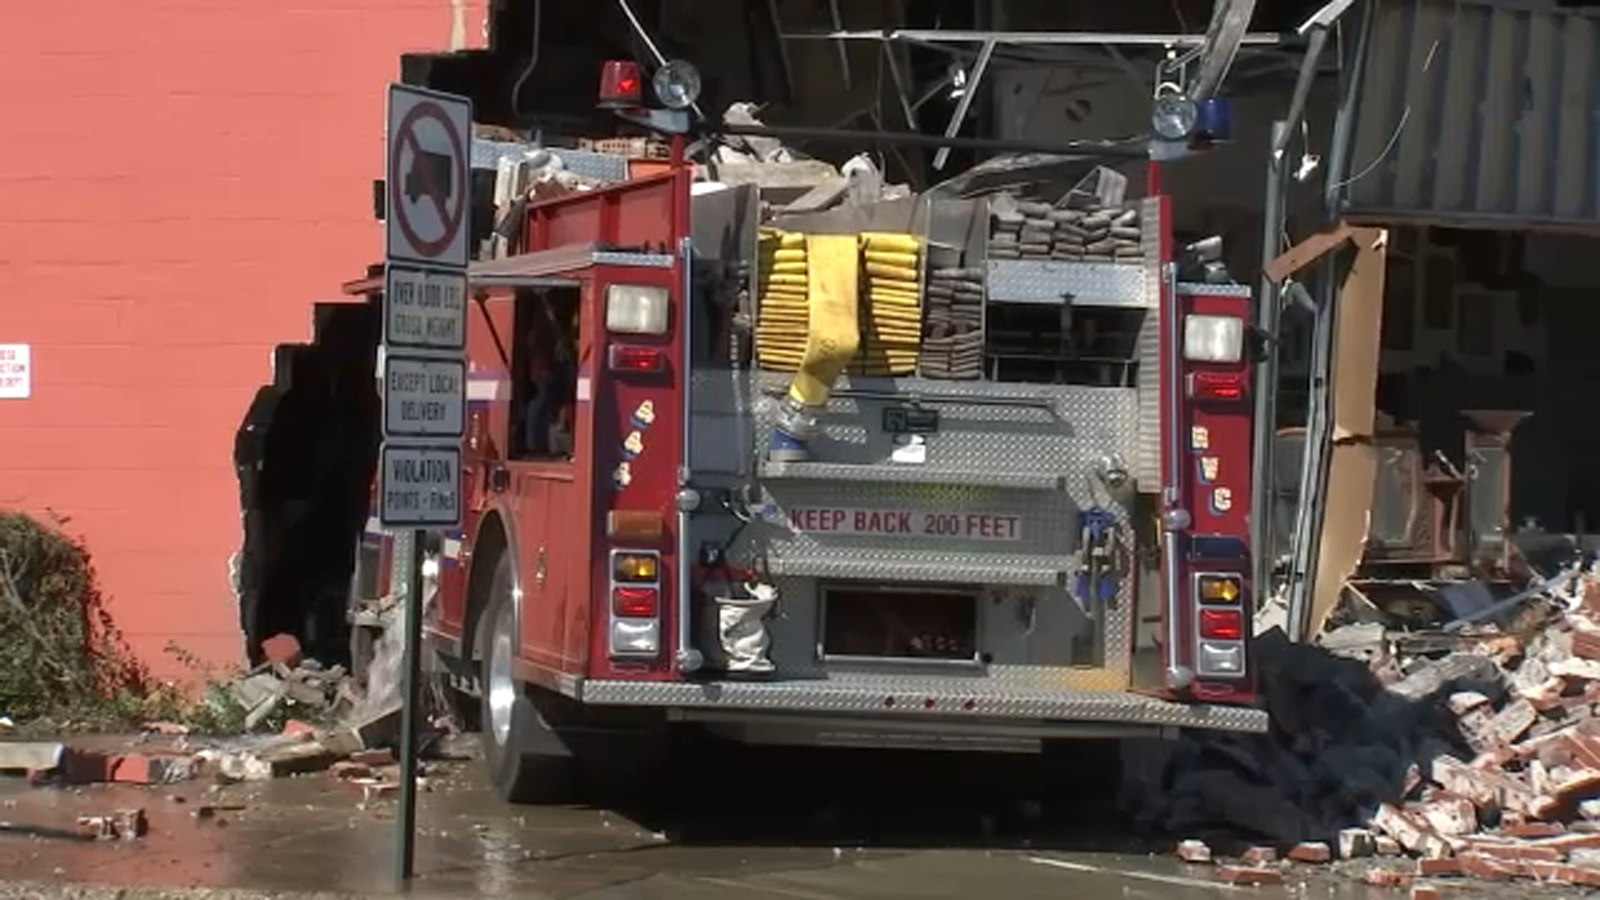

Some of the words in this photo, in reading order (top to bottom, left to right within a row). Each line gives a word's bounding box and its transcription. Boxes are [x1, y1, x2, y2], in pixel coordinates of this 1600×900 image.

[391, 371, 426, 394] EXCEPT
[430, 373, 459, 395] LOCAL
[401, 400, 446, 421] DELIVERY
[393, 459, 451, 484] VIOLATION
[387, 490, 419, 511] POINTS
[791, 508, 846, 531] KEEP
[854, 511, 911, 533] BACK
[924, 514, 959, 535] 200
[966, 514, 1018, 538] FEET
